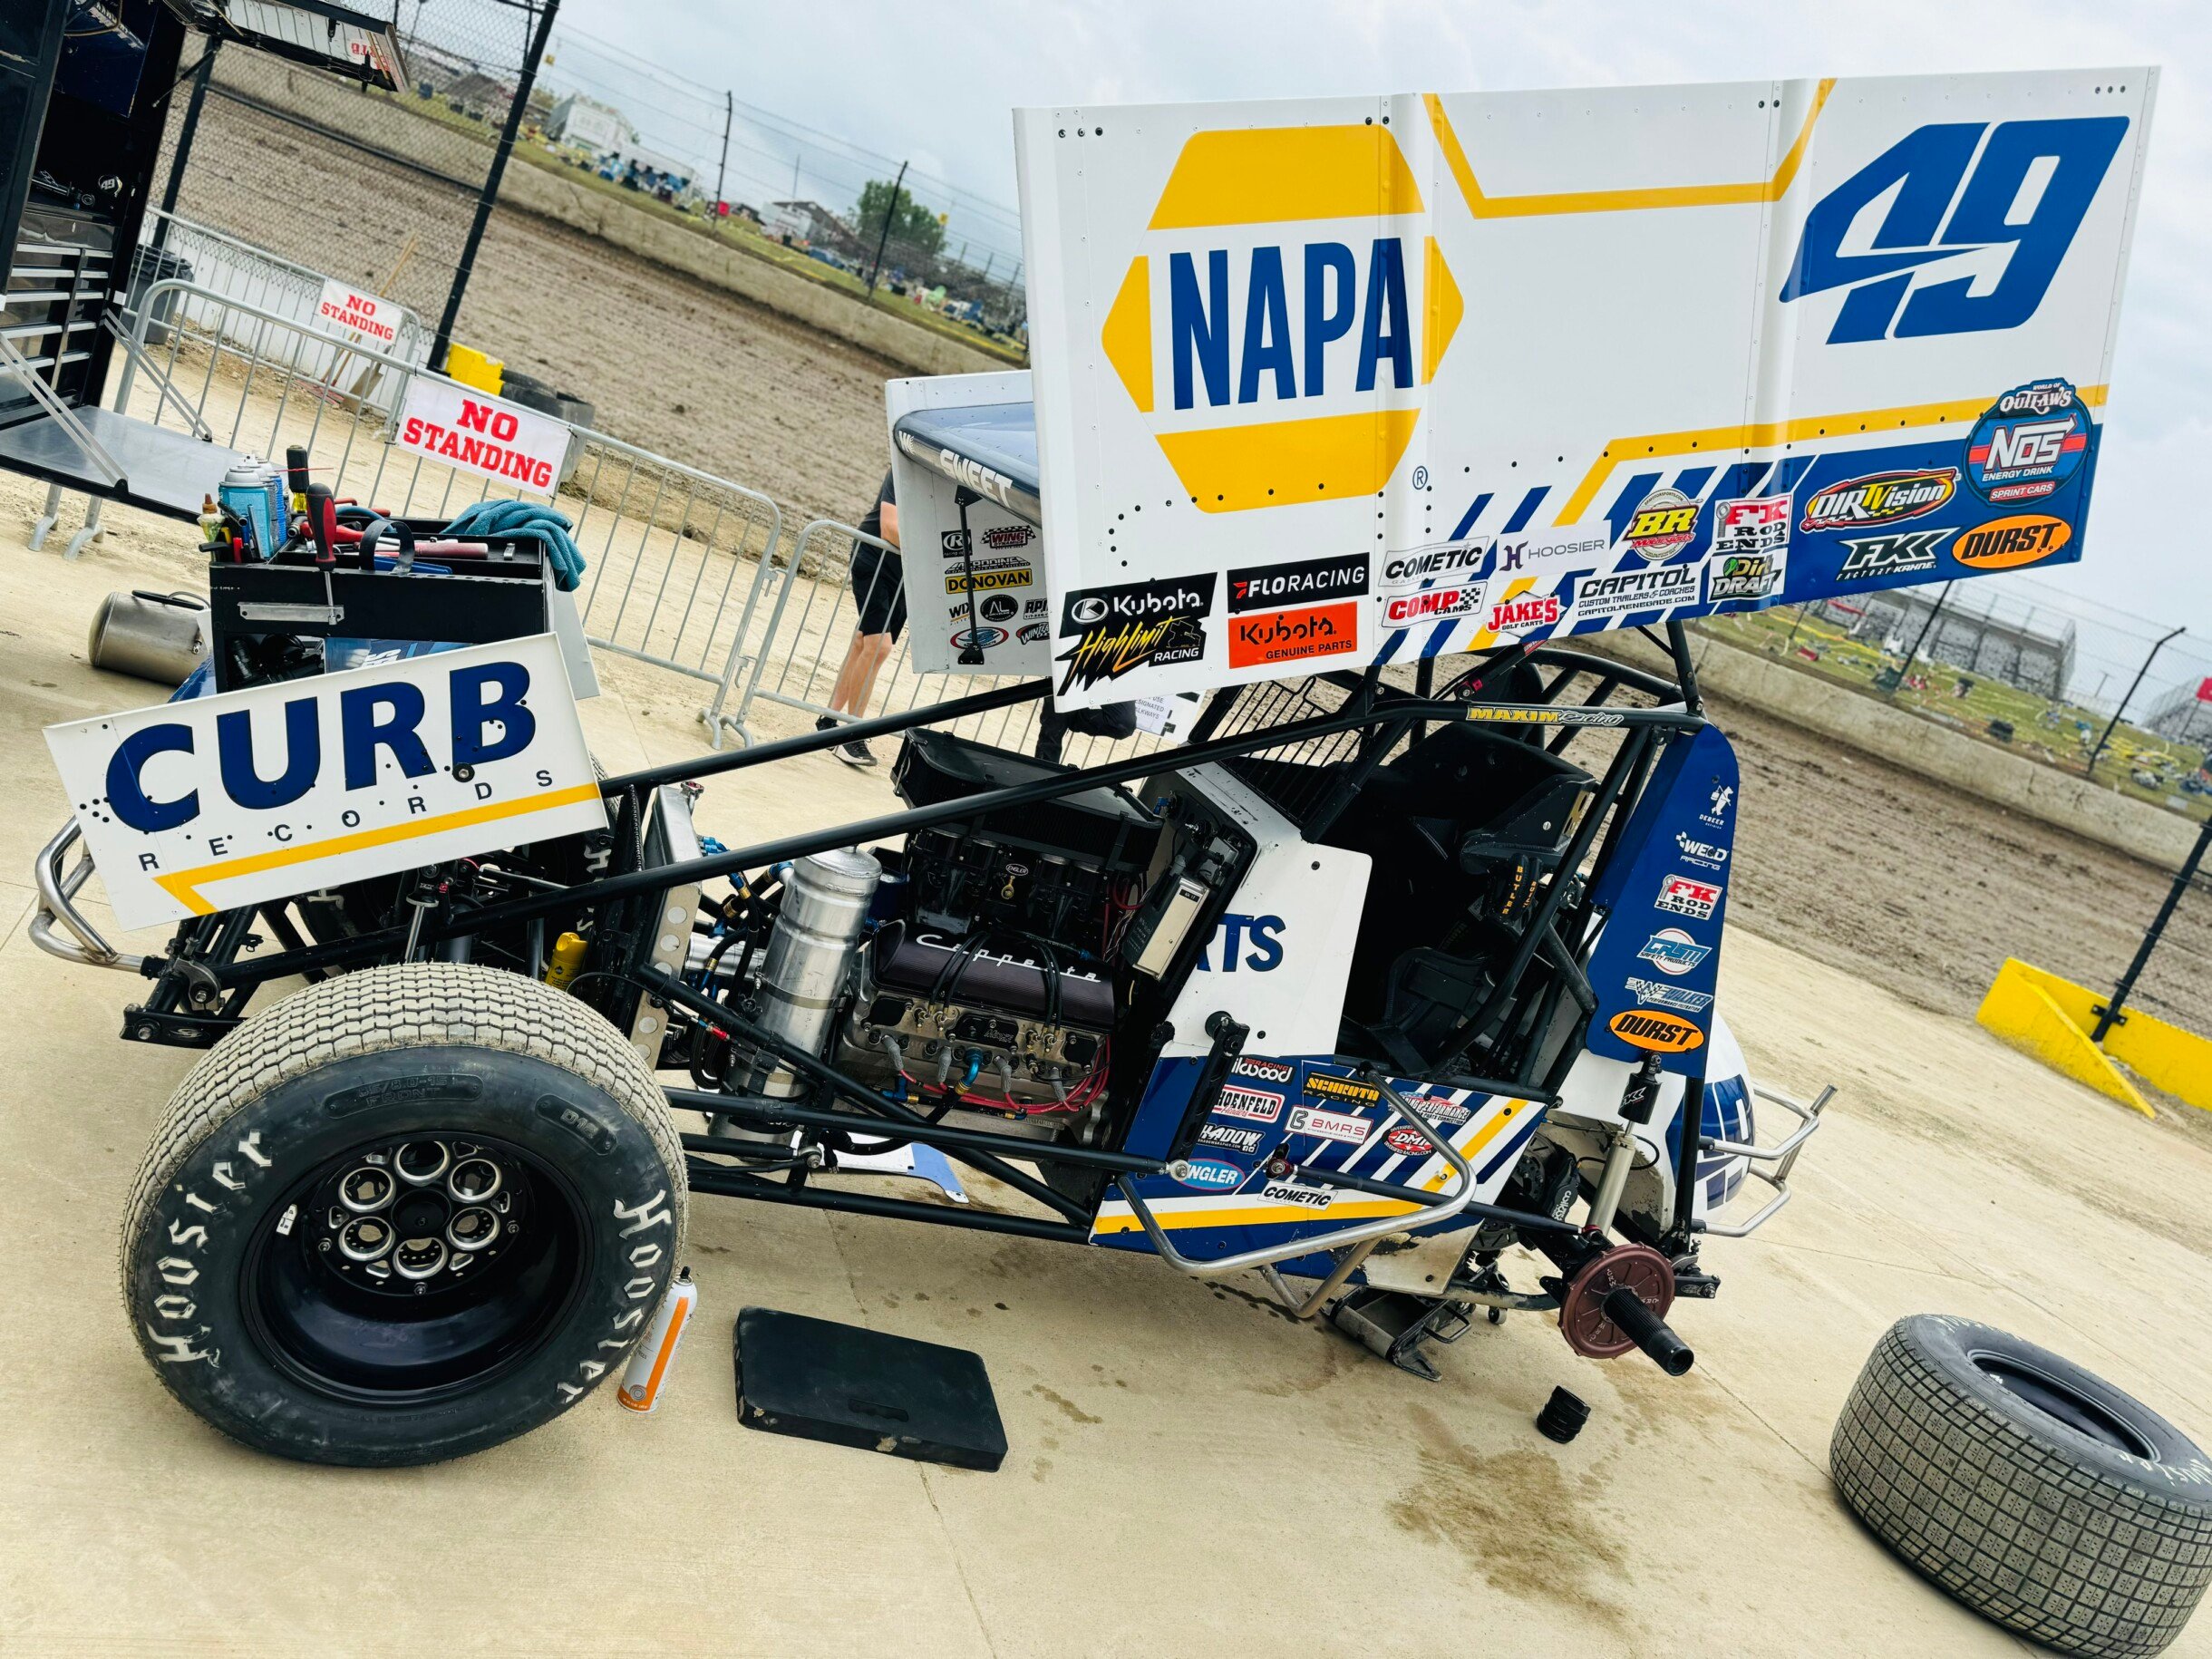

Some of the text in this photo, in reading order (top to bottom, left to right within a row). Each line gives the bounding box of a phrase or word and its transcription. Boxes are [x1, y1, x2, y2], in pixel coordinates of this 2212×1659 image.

[1778, 116, 2130, 344] 49
[346, 294, 376, 316] NO
[321, 302, 393, 341] STANDING
[1170, 238, 1414, 411] NAPA
[457, 399, 519, 442] NO
[403, 417, 552, 488] STANDING
[1984, 416, 2076, 471] NOS
[940, 448, 1013, 508] SWEET
[1982, 465, 2053, 481] ENERGY DRINK
[1992, 484, 2052, 499] SPRINT CARS
[1626, 508, 1697, 538] BR
[1725, 500, 1787, 525] FK
[992, 532, 1024, 543] WING
[1734, 521, 1787, 537] ROD
[1528, 539, 1606, 558] HOOSIER
[1716, 533, 1785, 550] ENDS
[1961, 522, 2062, 559] DURST
[1385, 547, 1482, 579] COMETIC
[1836, 561, 1936, 581] FACTORY KAHNE
[948, 571, 1031, 591] DONOVAN
[1248, 567, 1365, 598] FLORACING
[1579, 568, 1696, 598] CAPITOL
[1713, 572, 1777, 595] DRAFT
[1114, 588, 1200, 616] Kubota
[1389, 591, 1460, 620] COMP
[1577, 595, 1695, 616] CAPITOLRENEGADE.COM
[1578, 597, 1610, 608] CUSTOM
[1613, 591, 1649, 603] TRAILERS
[1659, 585, 1695, 597] COACHES
[1434, 604, 1472, 616] CAMS
[1489, 598, 1558, 631] JAKE'S
[1240, 616, 1336, 645] Kubota
[1521, 620, 1544, 628] CARTS
[1154, 647, 1199, 662] RACING
[1266, 640, 1353, 659] GENUINE PARTS
[1469, 707, 1624, 725] MAXIM Racing
[105, 661, 537, 833] CURB
[140, 769, 554, 871] RECORDS
[1699, 814, 1724, 826] DEBEER
[1683, 839, 1728, 862] WELD
[1680, 855, 1721, 871] RACING
[1502, 866, 1523, 915] BUTLER
[1669, 880, 1718, 903] FK
[1656, 900, 1709, 919] ENDS
[1671, 895, 1712, 910] ROD
[1640, 951, 1696, 967] SAFETY PRODUCTS
[1615, 1014, 1699, 1045] DURST
[1231, 1057, 1293, 1082] ilwood
[1256, 1060, 1289, 1072] RACING
[366, 1088, 441, 1108] FRONT
[1304, 1090, 1375, 1107] RACING
[1307, 1077, 1380, 1101] SCHROTH
[1218, 1091, 1277, 1115] HOENFELD
[1421, 1101, 1470, 1121] PERFORMANCE
[1200, 1125, 1262, 1145] HADOW
[1312, 1118, 1366, 1136] BMRS
[1395, 1132, 1427, 1146] DMI
[1188, 1164, 1238, 1185] NGLER
[1263, 1186, 1332, 1207] COMETIC
